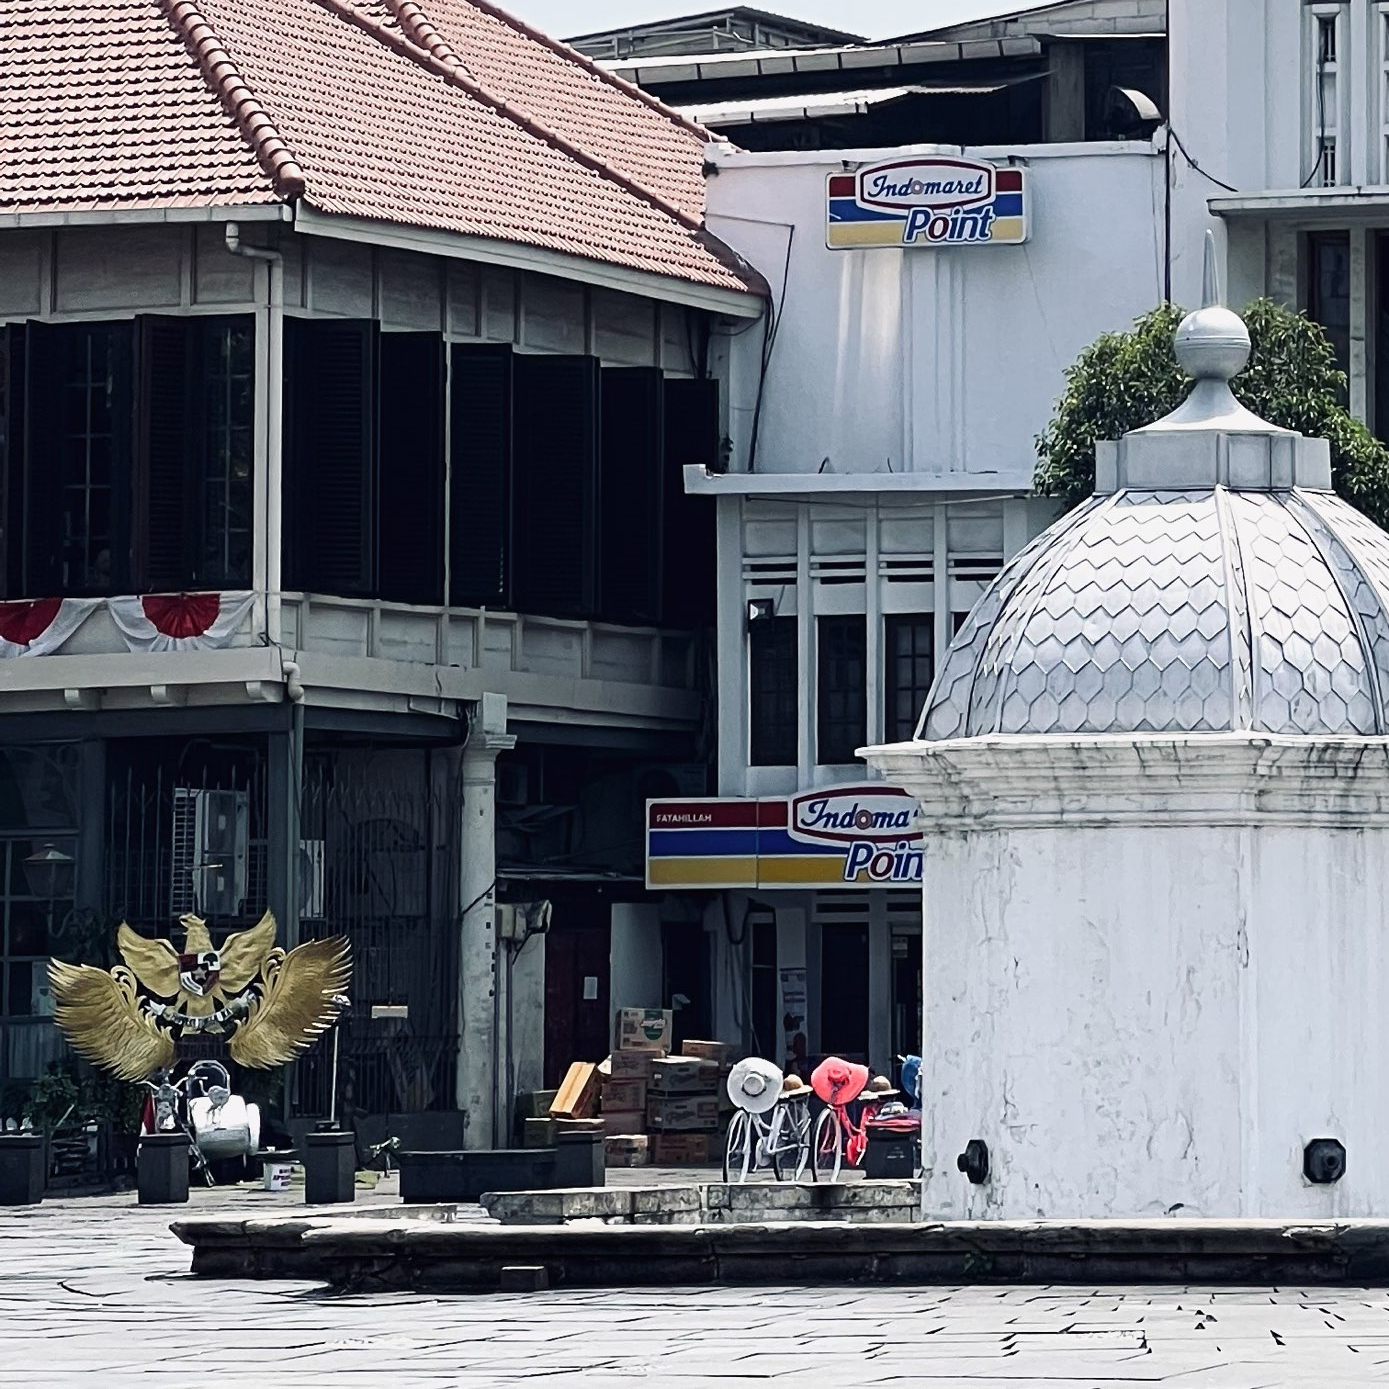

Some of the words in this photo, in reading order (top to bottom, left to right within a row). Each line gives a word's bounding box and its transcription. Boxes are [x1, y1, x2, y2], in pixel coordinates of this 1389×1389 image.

[867, 174, 984, 197] Indomaret
[905, 205, 994, 241] Point
[800, 799, 918, 828] Indoma
